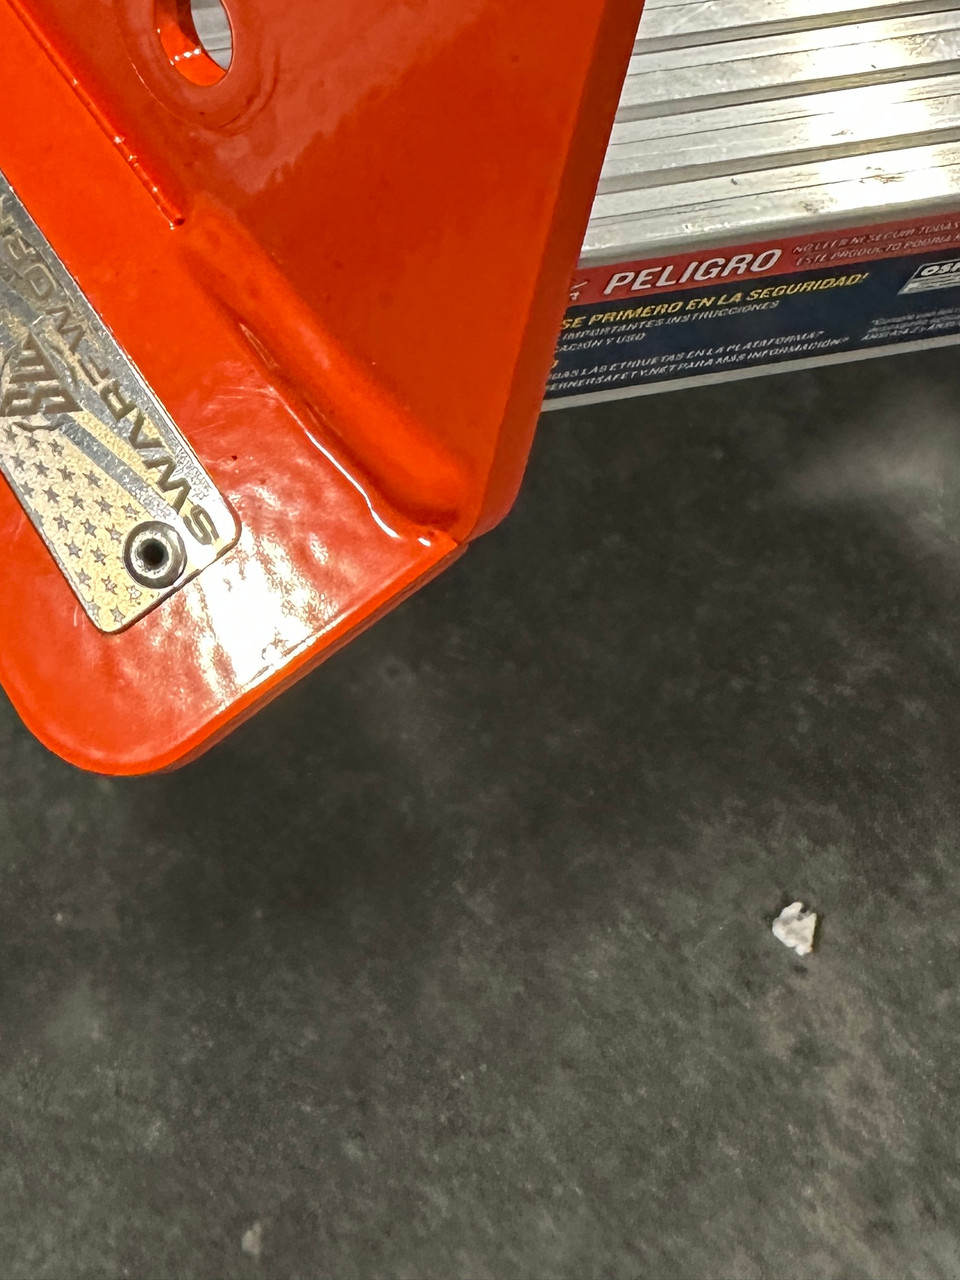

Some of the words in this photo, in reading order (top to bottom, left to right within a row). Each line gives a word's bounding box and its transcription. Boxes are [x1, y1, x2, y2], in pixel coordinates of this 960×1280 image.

[603, 248, 782, 295] PELIGRO
[588, 300, 683, 326] PRIMERO
[685, 296, 714, 311] EN
[717, 292, 743, 305] LA
[746, 272, 869, 301] SEGURIDAD!
[562, 318, 664, 340] IMPORTANTES
[665, 300, 780, 326] INSTRUCCIONES
[616, 331, 646, 345] USO
[608, 352, 685, 372] ETIQUETAS
[686, 349, 705, 360] EN
